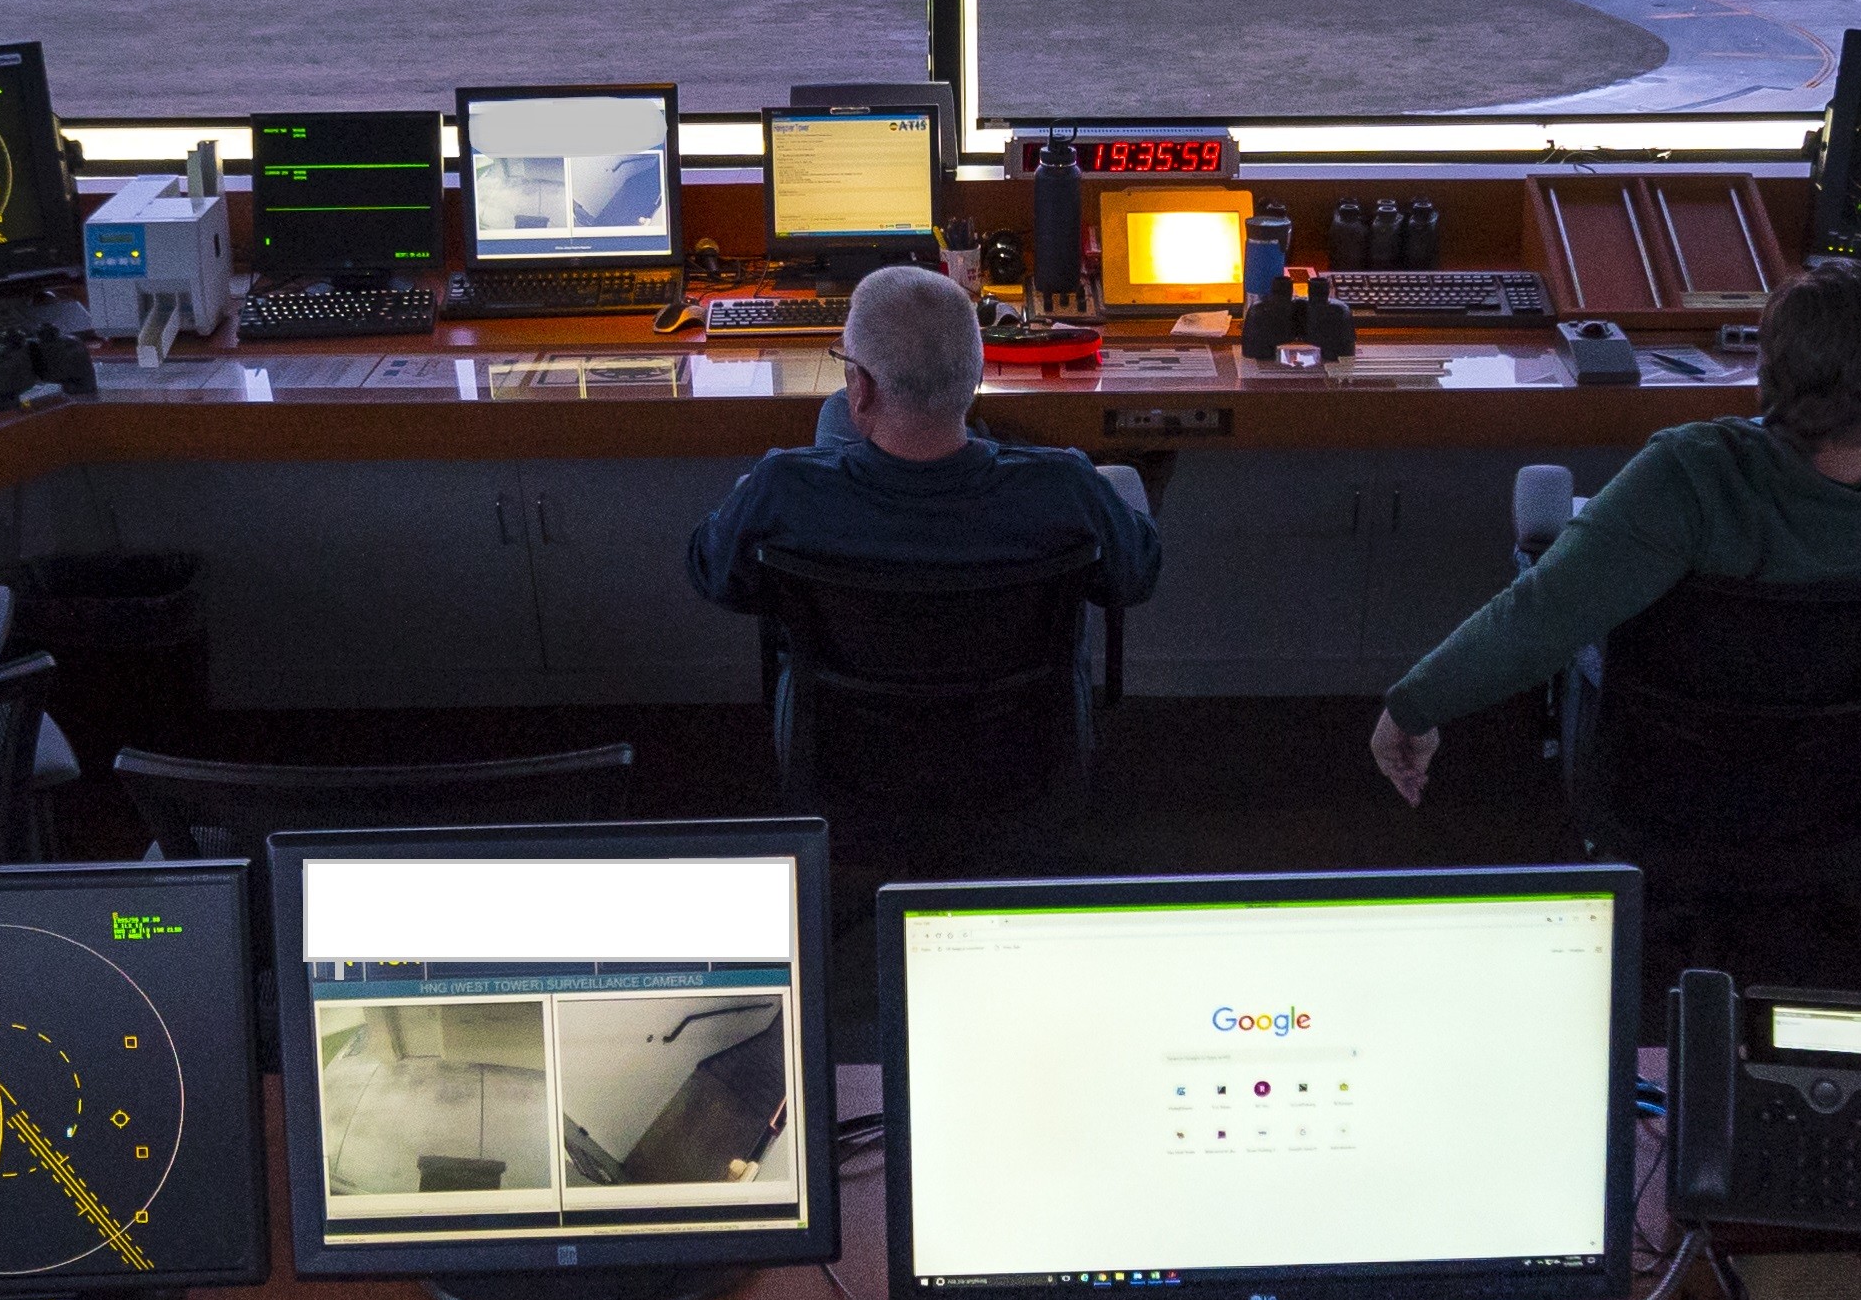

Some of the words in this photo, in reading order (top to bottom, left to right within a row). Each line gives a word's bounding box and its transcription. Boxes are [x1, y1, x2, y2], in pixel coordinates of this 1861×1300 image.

[898, 120, 927, 131] ATIS
[1094, 141, 1221, 172] 19:35:59
[419, 983, 448, 994] HNG
[449, 980, 490, 994] (WEST
[492, 979, 544, 994] TOWER)
[546, 976, 641, 991] SURVEILLANCE
[642, 974, 704, 989] CAMERAS
[1212, 1005, 1311, 1037] Google
